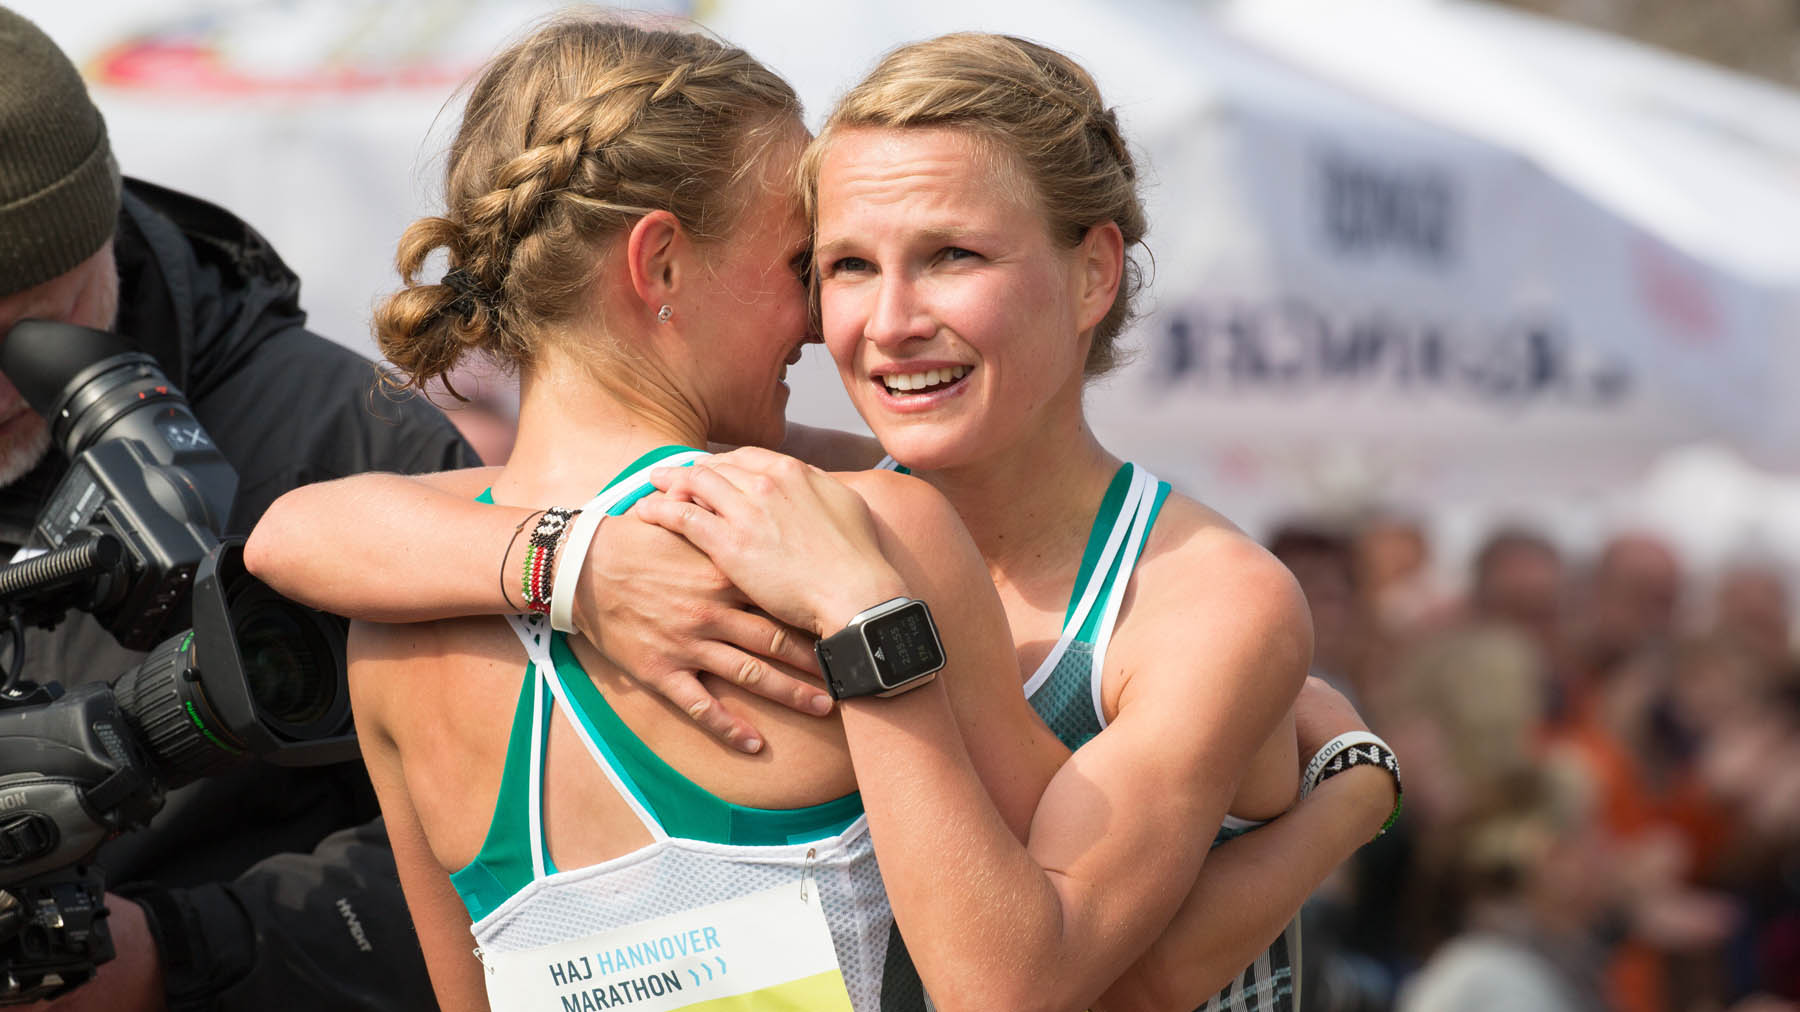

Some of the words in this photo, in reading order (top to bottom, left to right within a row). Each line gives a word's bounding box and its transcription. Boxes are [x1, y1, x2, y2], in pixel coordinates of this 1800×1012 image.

[549, 956, 593, 987] HAJ
[596, 926, 721, 976] HANNOVER
[560, 969, 683, 1012] MARATHON
